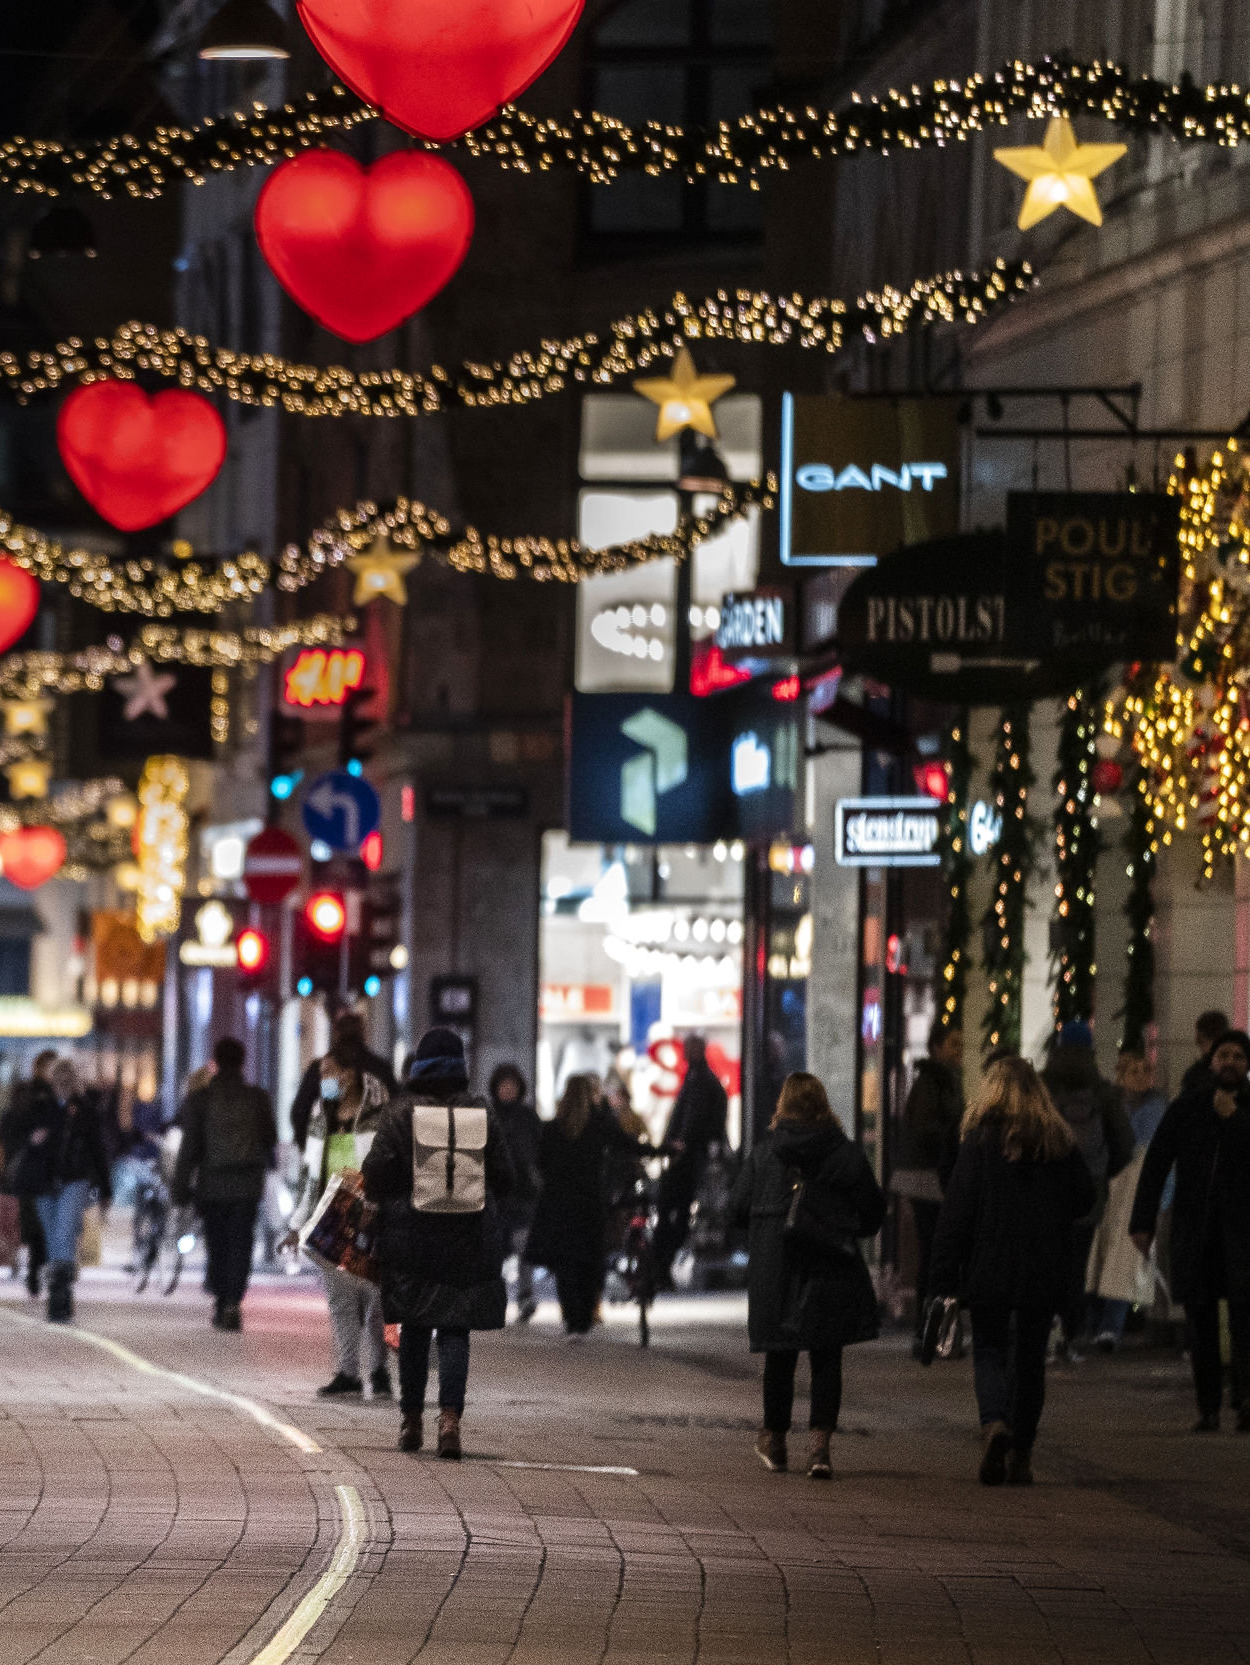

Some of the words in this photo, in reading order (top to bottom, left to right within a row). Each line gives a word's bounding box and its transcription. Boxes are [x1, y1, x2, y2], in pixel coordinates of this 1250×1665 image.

[796, 461, 948, 493] GANT
[1035, 516, 1152, 555] POUL
[1045, 562, 1138, 602] STIG
